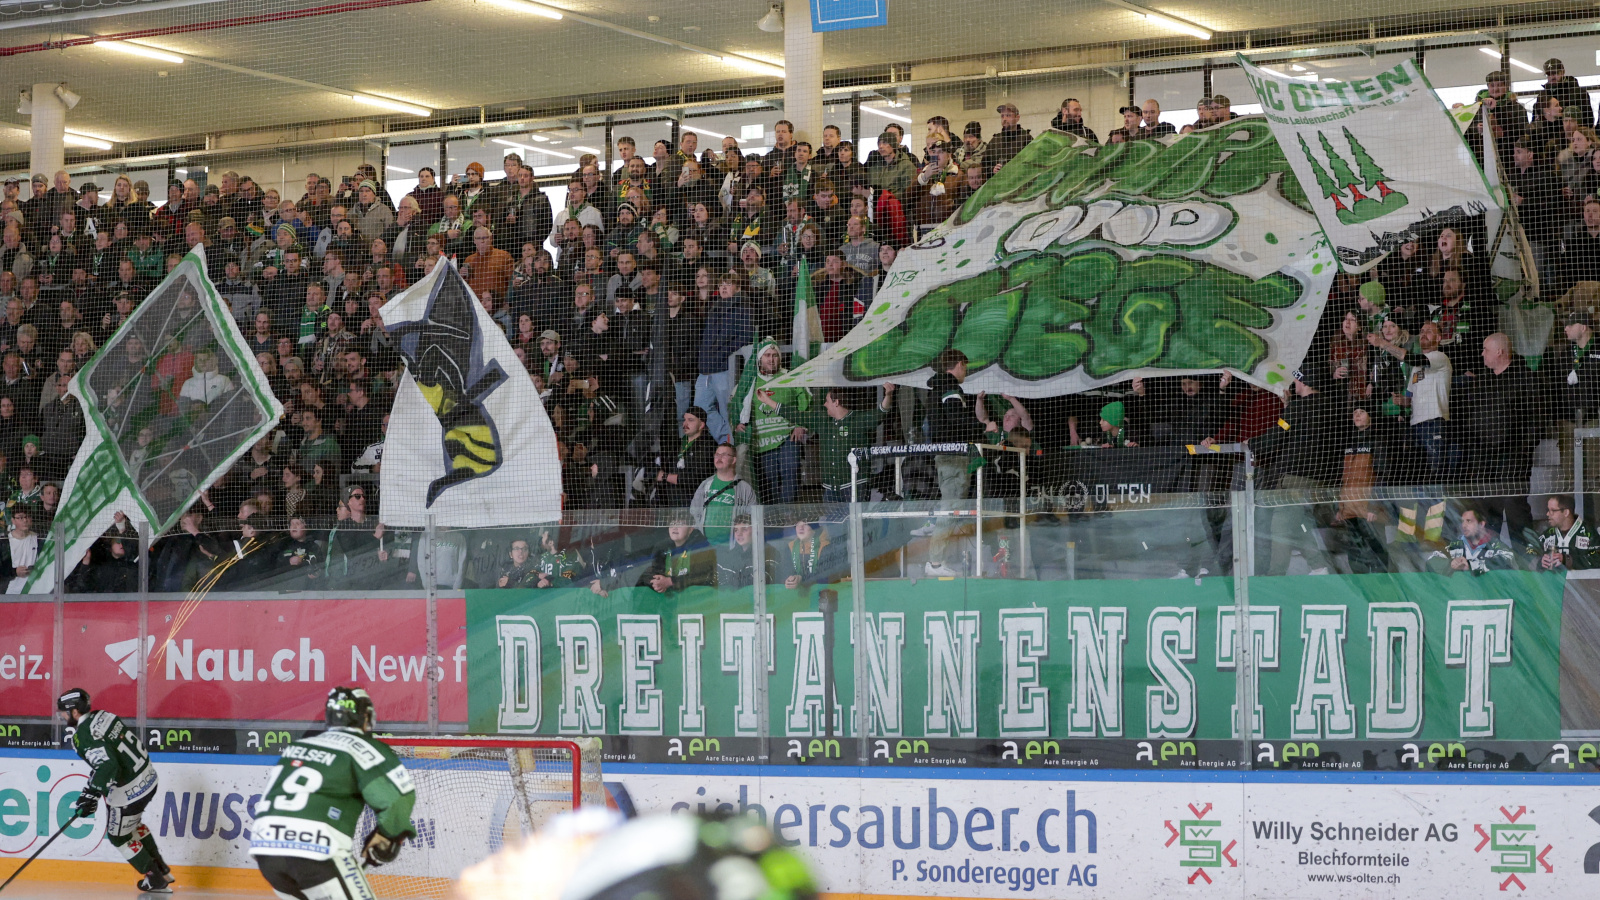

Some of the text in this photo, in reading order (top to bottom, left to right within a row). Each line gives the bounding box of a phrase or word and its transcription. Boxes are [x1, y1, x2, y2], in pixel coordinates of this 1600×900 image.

[1246, 64, 1413, 113] HC OLTEN
[1290, 106, 1356, 126] Leidenschaft
[870, 446, 891, 455] GEGEN
[892, 445, 908, 453] ALLE
[1095, 483, 1151, 504] OLTEN
[165, 637, 325, 682] Nau.ch
[351, 645, 444, 682] News
[496, 599, 1513, 739] DREITANNENSTADT
[282, 745, 337, 766] NELSEN
[723, 755, 746, 763] Energie
[930, 757, 956, 765] Energie
[1061, 758, 1088, 767] Energie
[1198, 760, 1225, 768] Energie
[1302, 760, 1319, 768] Aare
[1321, 761, 1350, 769] Energie
[1448, 761, 1465, 769] Aare
[1466, 762, 1497, 770] Energie
[255, 765, 323, 815] 19
[1252, 820, 1459, 844] Willy Schneider AG
[1298, 851, 1410, 867] Blechformteile
[892, 859, 1098, 892] P. Sonderegger AG
